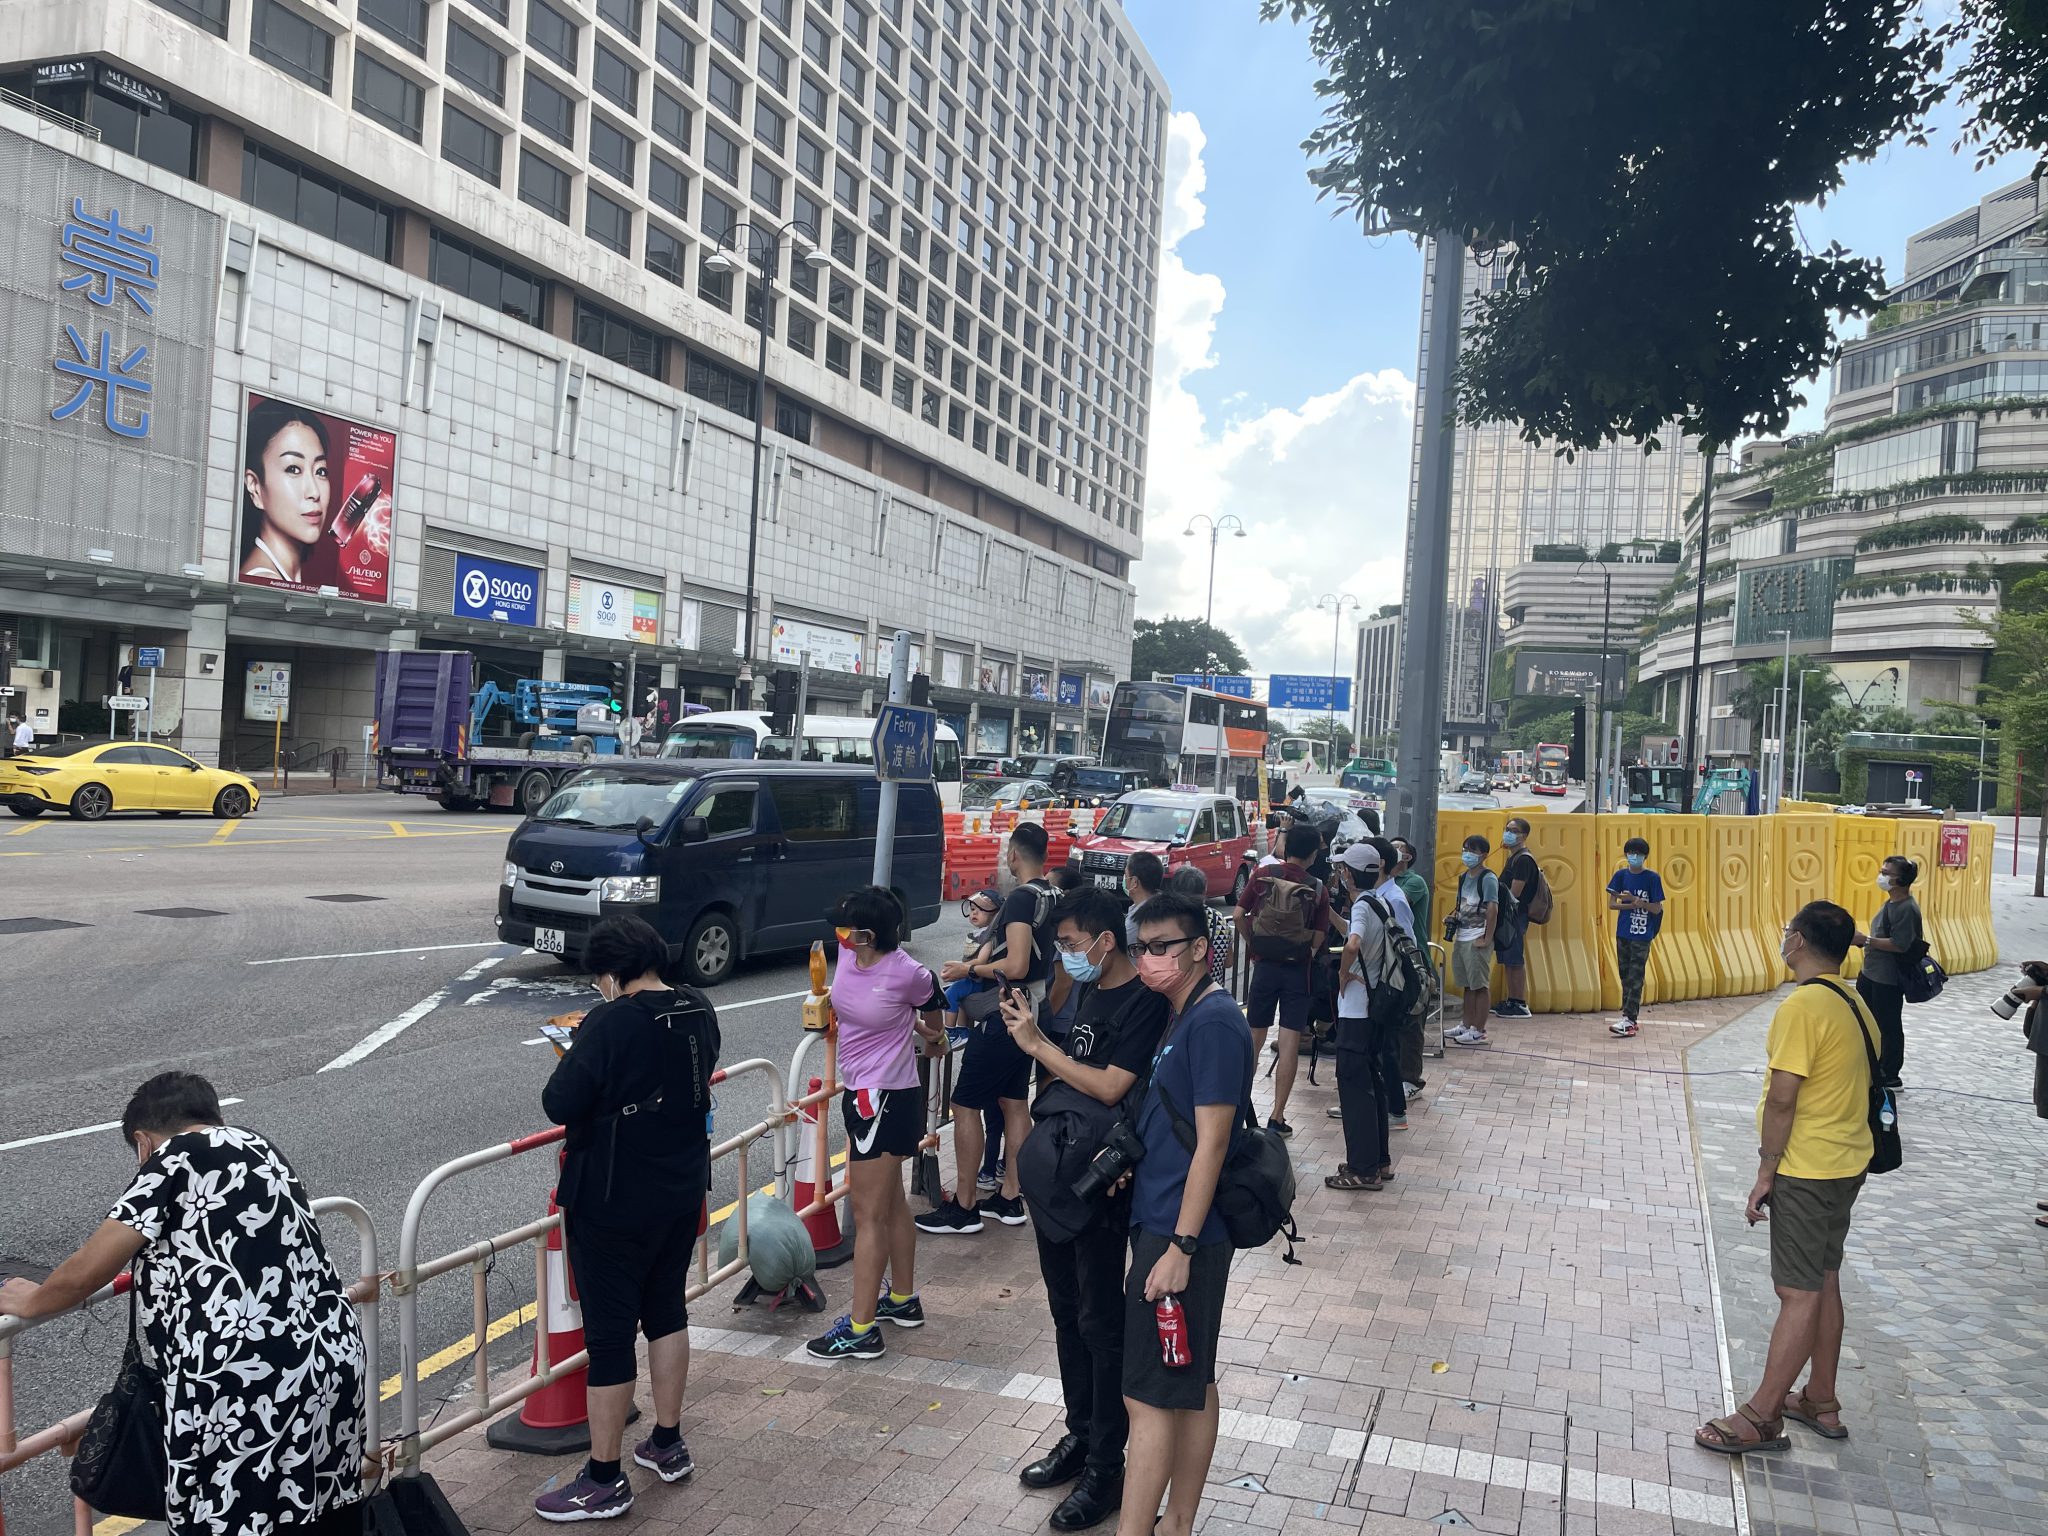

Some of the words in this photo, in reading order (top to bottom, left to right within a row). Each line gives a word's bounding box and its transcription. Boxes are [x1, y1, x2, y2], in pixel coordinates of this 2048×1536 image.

[52, 196, 160, 438] 崇光
[350, 426, 373, 439] POWER
[373, 433, 379, 441] IS
[380, 435, 392, 444] YOU
[345, 566, 382, 580] SHISEIDO
[490, 577, 532, 601] SOGO
[1749, 566, 1808, 618] K11
[495, 600, 511, 609] HONG
[511, 602, 526, 611] KONG
[597, 610, 616, 622] SOGO
[1549, 669, 1594, 677] ROSEWOOD
[893, 714, 917, 738] Ferry
[892, 743, 917, 769] 渡輪
[1351, 800, 1377, 808] TAXI
[543, 928, 556, 941] KA
[536, 938, 563, 952] 9506
